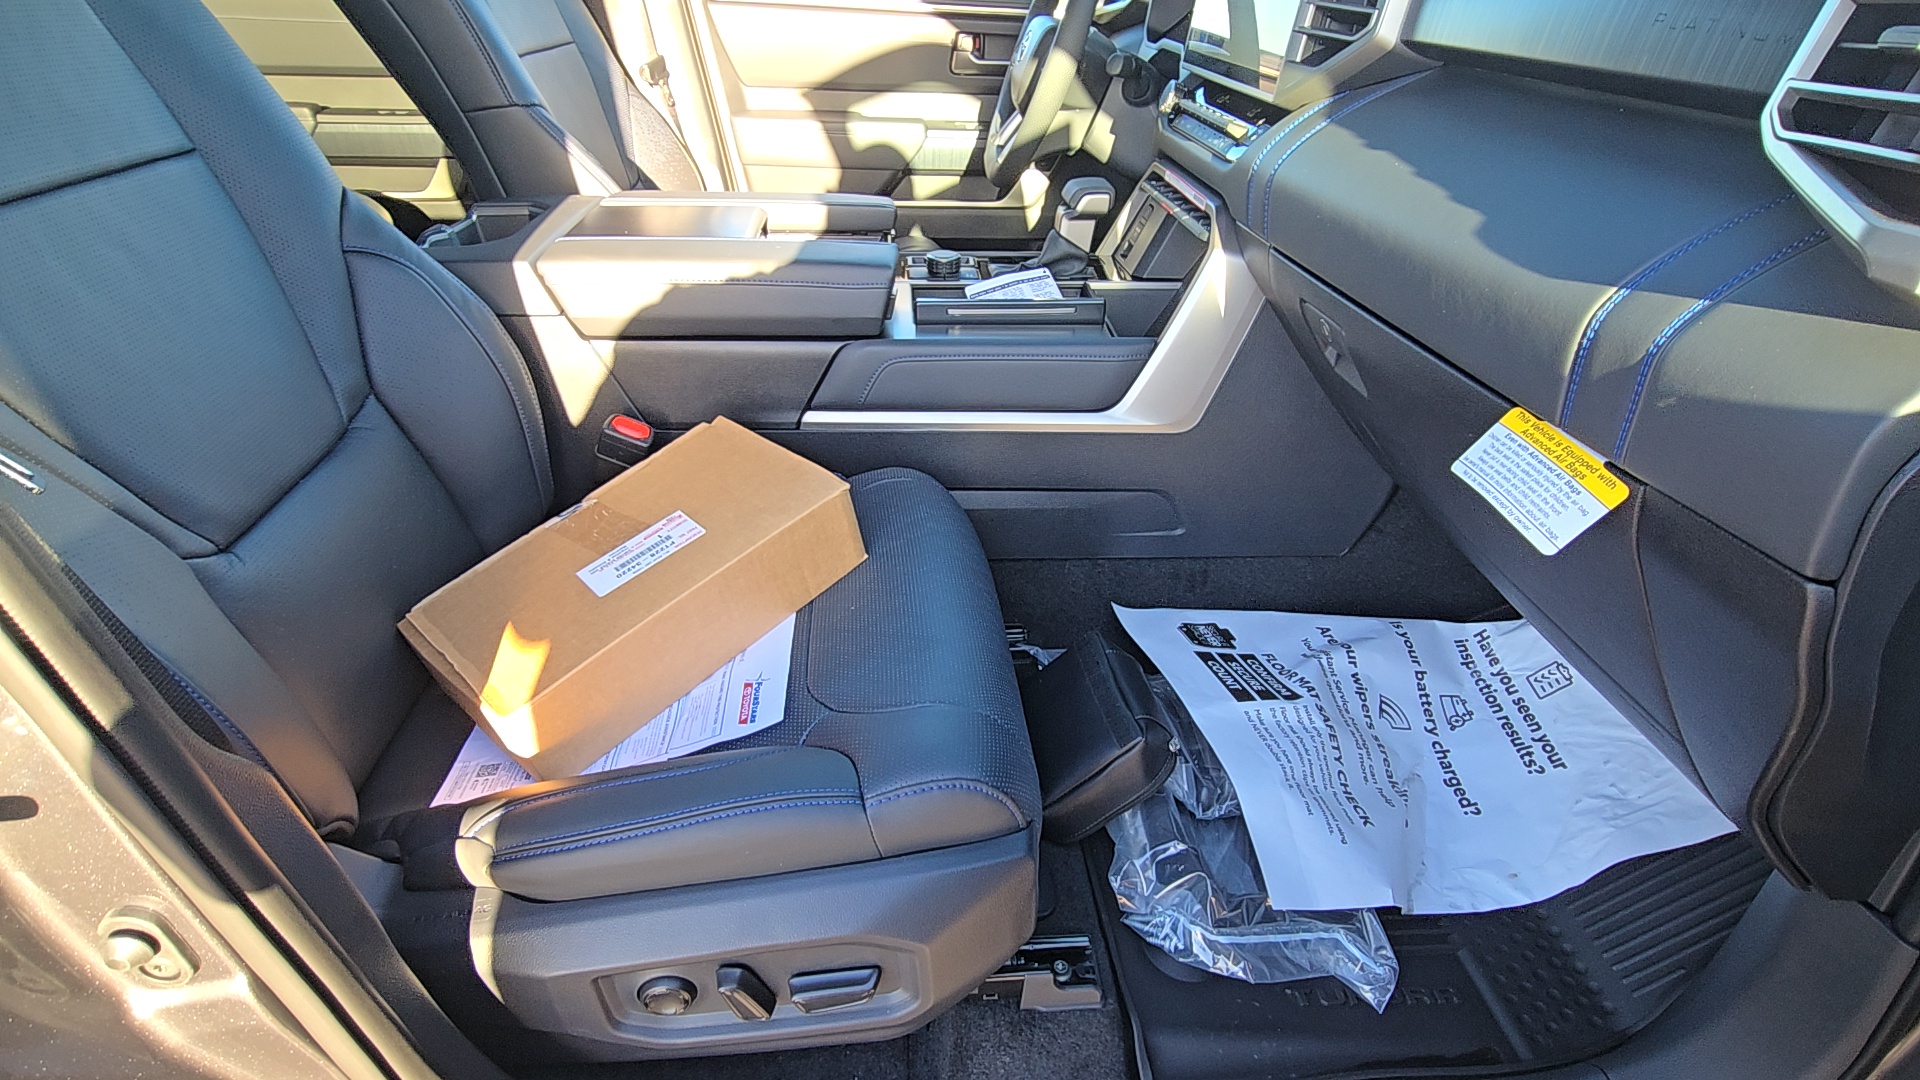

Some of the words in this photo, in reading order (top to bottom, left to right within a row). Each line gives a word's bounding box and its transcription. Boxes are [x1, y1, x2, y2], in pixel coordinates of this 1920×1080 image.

[1651, 12, 1795, 45] PLATNUM
[1504, 432, 1518, 444] Even
[1516, 441, 1530, 453] with
[1527, 449, 1557, 474] Advanced
[1554, 471, 1565, 482] Air
[1563, 479, 1582, 496] Bags
[1515, 411, 1531, 424] This
[1529, 421, 1555, 442] Vehicle
[1553, 439, 1563, 448] is
[1561, 444, 1599, 474] Equipped
[1596, 471, 1618, 490] with
[1519, 427, 1557, 456] Advanced
[1552, 452, 1568, 465] Air
[1564, 461, 1586, 480] Bags
[1491, 494, 1509, 510] except
[1506, 508, 1516, 516] by
[1556, 485, 1564, 493] by
[1562, 491, 1572, 500] the
[1388, 621, 1404, 629] Is
[1394, 630, 1422, 667] your
[1207, 661, 1242, 691] COUNT
[1227, 661, 1266, 691] SECURE
[1247, 659, 1292, 696] CONFIRM
[1315, 626, 1339, 645] Are
[1340, 643, 1358, 668] our
[1350, 671, 1375, 730] wipers
[1473, 628, 1500, 667] Have
[1490, 666, 1519, 696] you
[1512, 697, 1542, 733] seen
[1531, 734, 1568, 769] your
[1293, 705, 1311, 734] designed
[1303, 704, 1317, 726] Install
[1414, 670, 1439, 737] battery
[1454, 639, 1503, 714] inspection
[1496, 715, 1546, 774] results?
[1244, 710, 1254, 723] and
[1252, 723, 1268, 742] NEVER
[1264, 742, 1282, 763] double
[1254, 708, 1266, 726] Make
[1263, 726, 1274, 739] sure
[1272, 738, 1282, 749] you
[1280, 749, 1292, 764] have
[1304, 800, 1314, 816] mat
[1261, 653, 1298, 682] FLOOR
[1296, 676, 1321, 702] MAT
[1315, 702, 1344, 767] SAFETY
[1337, 769, 1375, 828] CHECK
[1333, 679, 1350, 714] Service
[1348, 716, 1372, 763] Manager
[1369, 763, 1378, 785] can
[1375, 787, 1396, 808] help
[1349, 729, 1363, 751] and
[1358, 752, 1370, 785] more.
[1280, 706, 1290, 725] Floor
[1296, 736, 1311, 757] should
[1335, 823, 1348, 845] using
[1431, 740, 1482, 816] charged?
[1285, 986, 1462, 1007] TURA
